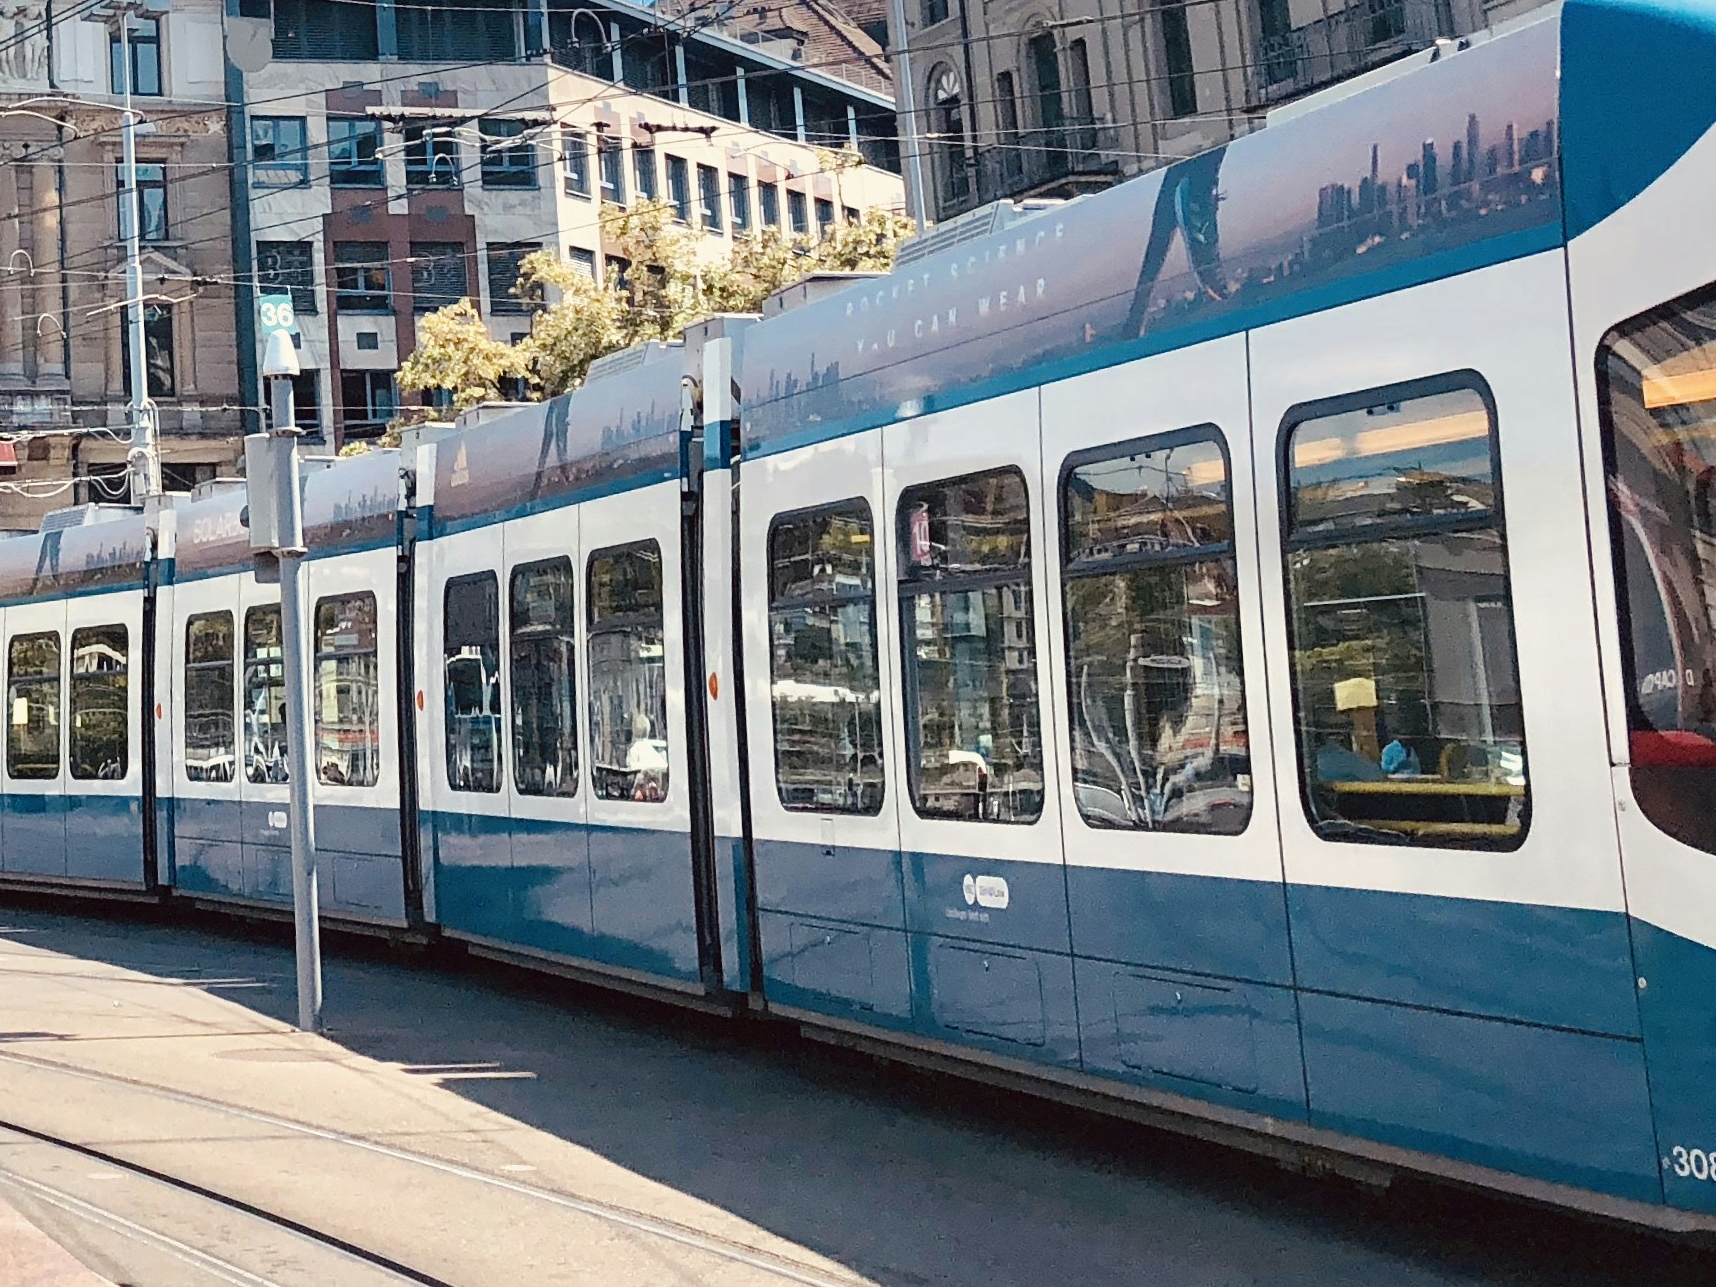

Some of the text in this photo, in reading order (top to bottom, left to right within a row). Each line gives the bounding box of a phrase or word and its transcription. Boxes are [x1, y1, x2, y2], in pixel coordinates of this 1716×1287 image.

[845, 223, 1064, 317] ROCKET SCIENCE
[260, 302, 294, 328] 36
[913, 306, 958, 339] CAN
[977, 277, 1046, 317] WEAR
